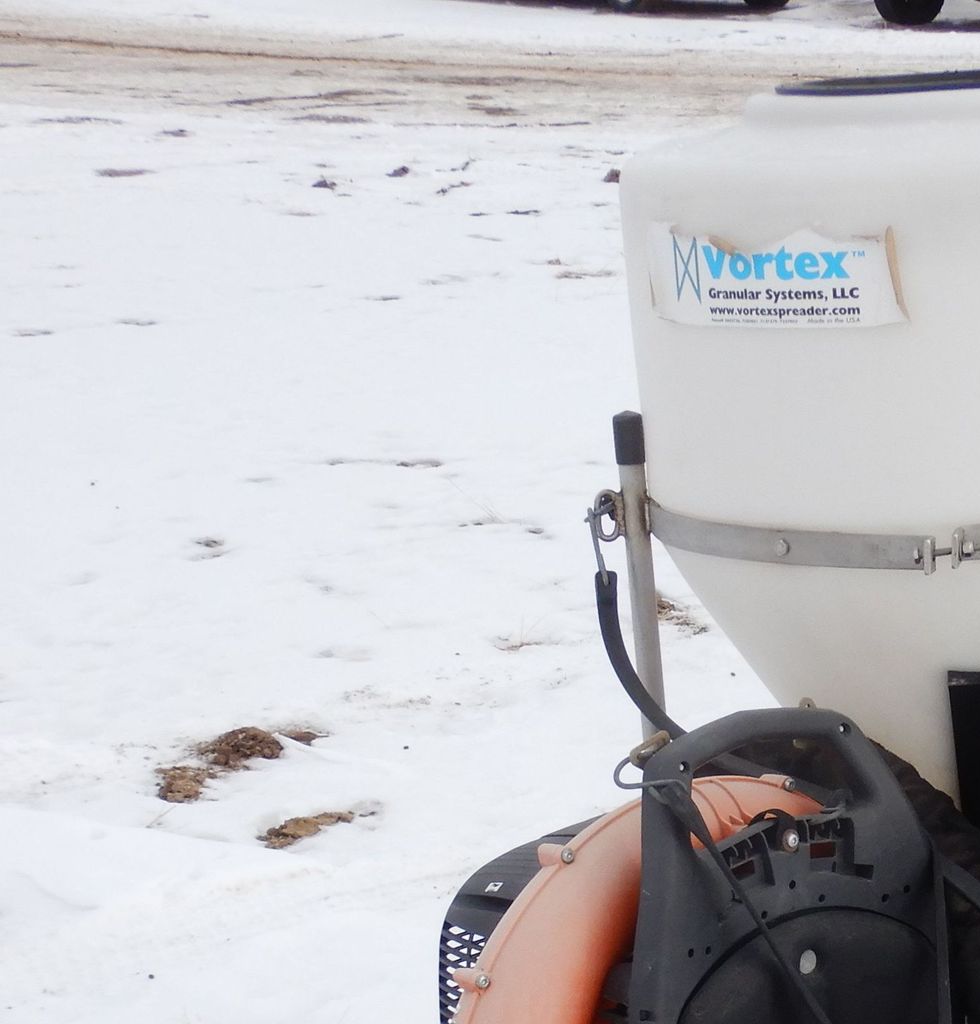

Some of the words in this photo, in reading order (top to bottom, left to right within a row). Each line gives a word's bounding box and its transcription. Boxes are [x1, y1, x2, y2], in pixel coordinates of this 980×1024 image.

[702, 245, 851, 281] Vortex
[708, 287, 762, 300] Granular
[765, 288, 828, 303] Systems,
[832, 287, 860, 299] LLC
[709, 306, 861, 319] www.vortexspreader.com
